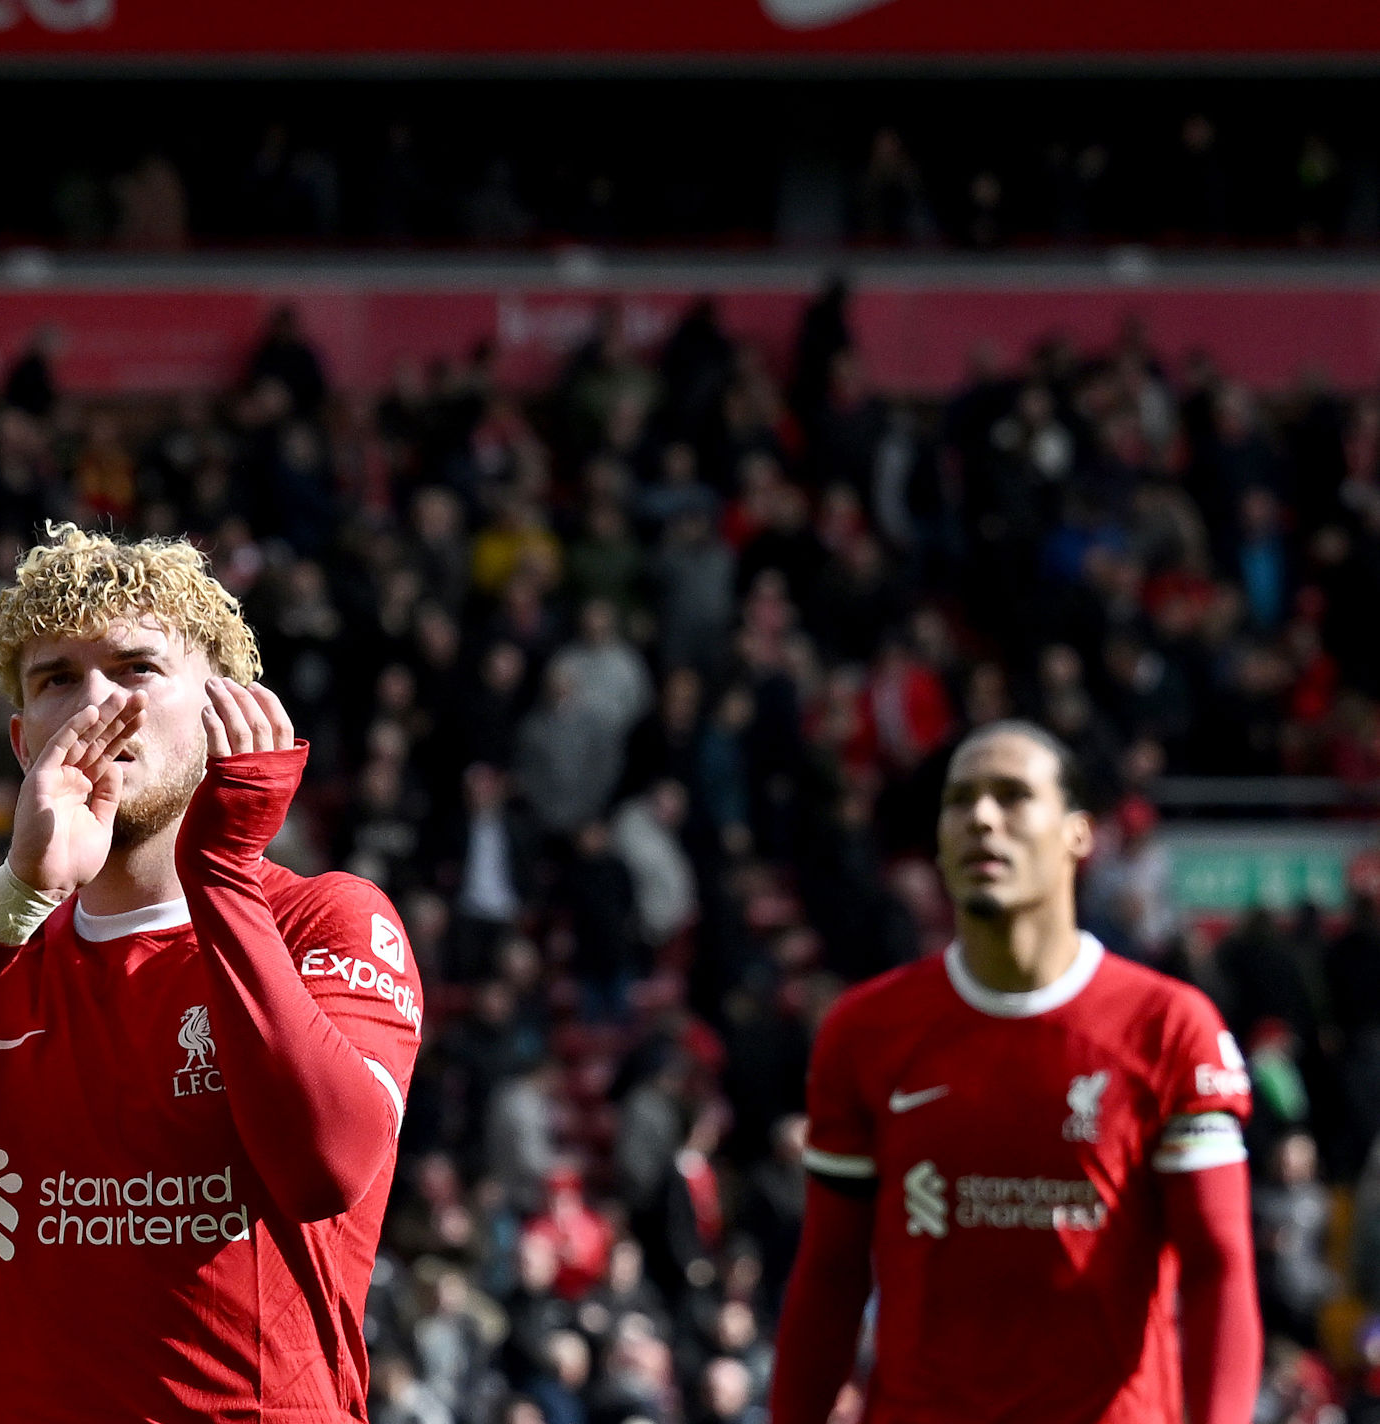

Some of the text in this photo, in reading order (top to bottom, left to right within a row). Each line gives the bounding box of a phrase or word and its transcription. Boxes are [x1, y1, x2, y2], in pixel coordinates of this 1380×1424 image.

[173, 1070, 227, 1097] L.F.C.
[39, 1165, 233, 1207] standard
[37, 1203, 250, 1246] chartered
